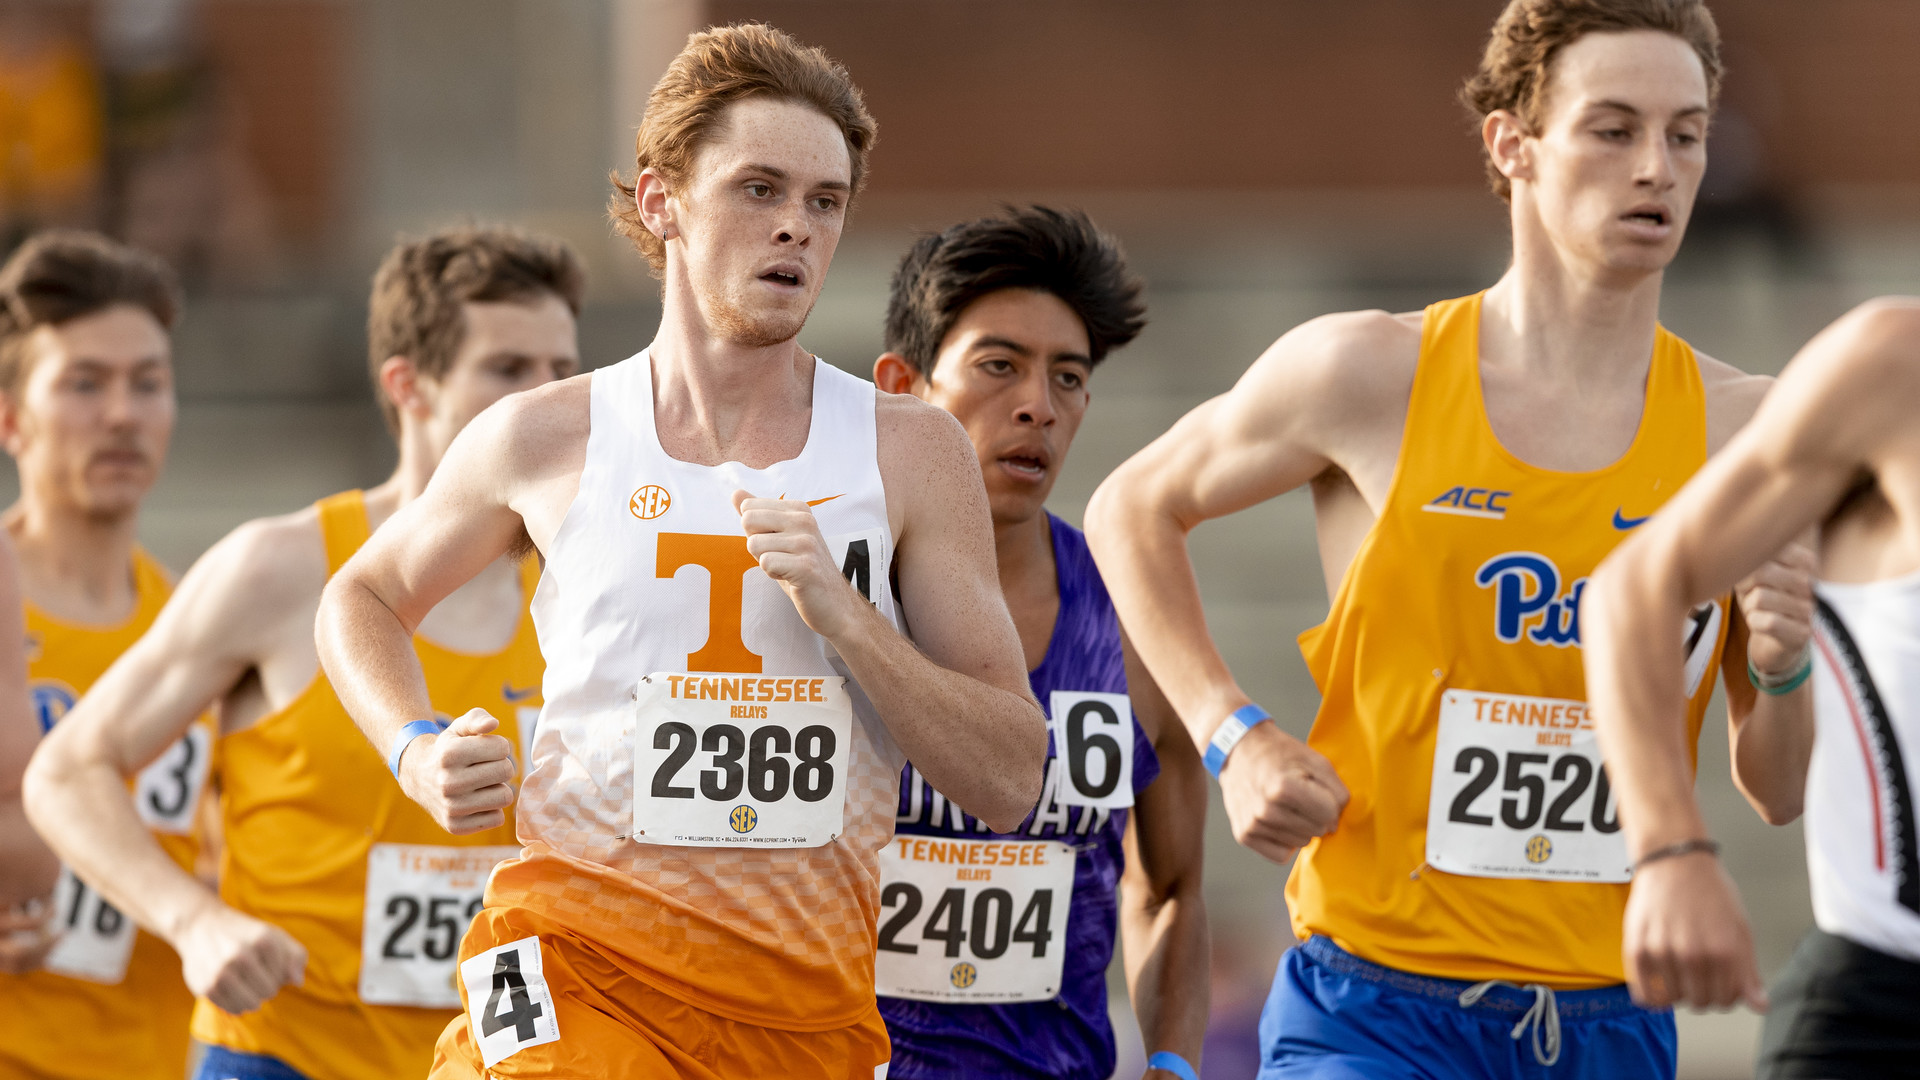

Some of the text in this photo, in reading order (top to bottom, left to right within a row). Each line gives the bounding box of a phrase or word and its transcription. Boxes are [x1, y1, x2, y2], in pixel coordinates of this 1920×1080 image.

[630, 485, 671, 520] SEC
[1431, 485, 1513, 512] ACC
[656, 532, 762, 674] T
[1475, 551, 1588, 648] Pit
[667, 675, 825, 702] TENNESSEE
[730, 705, 768, 719] RELAYS
[1473, 698, 1597, 730] TENNESS
[1067, 700, 1121, 799] 6
[1536, 732, 1572, 746] RELAYS
[148, 733, 197, 818] 3
[651, 721, 836, 803] 2368
[729, 804, 758, 833] SEC
[897, 838, 1047, 866] TENNESSEE
[956, 868, 992, 881] RELAYS
[382, 893, 484, 962] 25
[877, 882, 1053, 960] 2404
[481, 948, 543, 1043] 4
